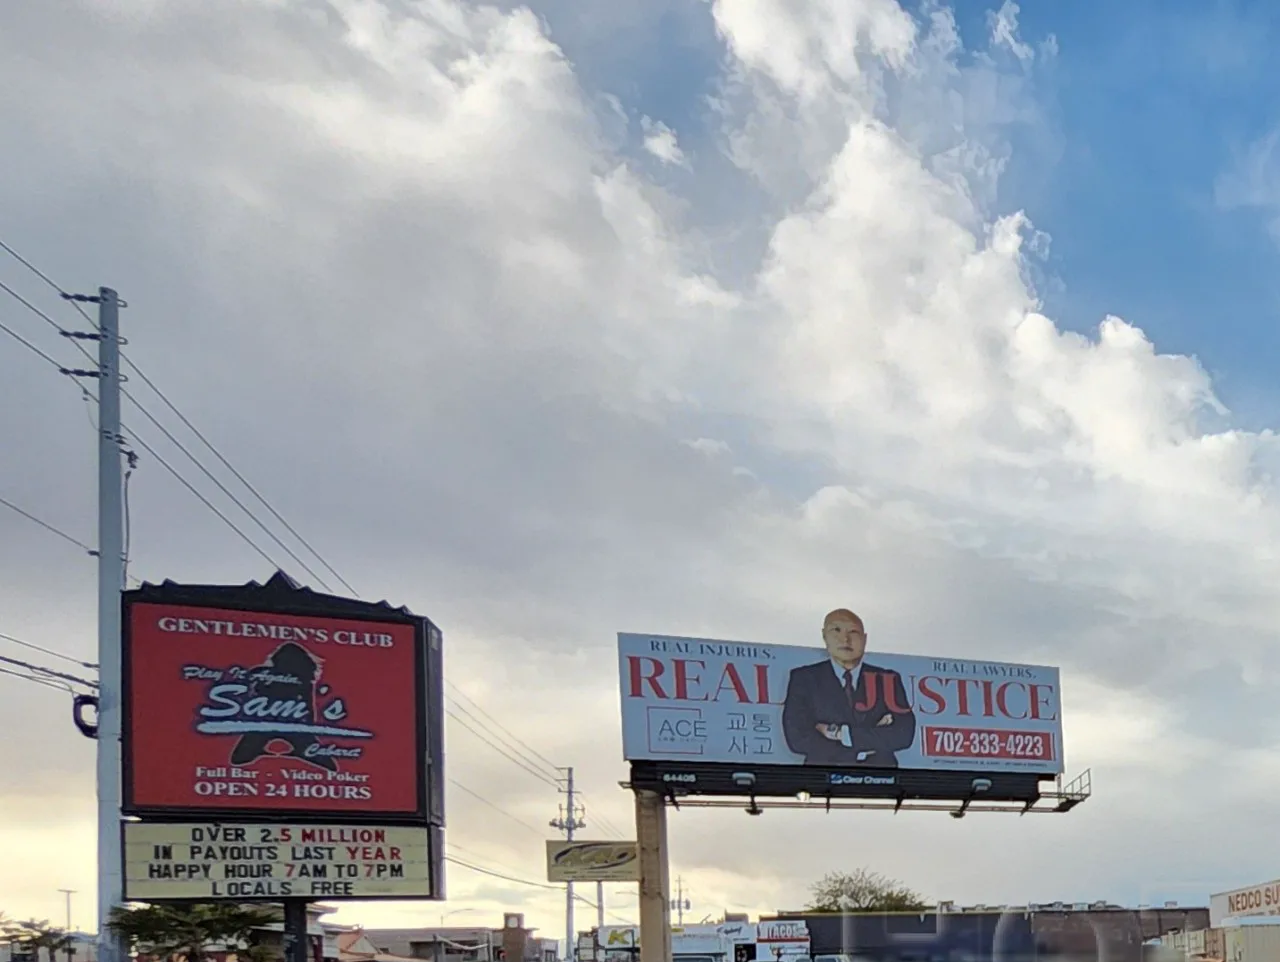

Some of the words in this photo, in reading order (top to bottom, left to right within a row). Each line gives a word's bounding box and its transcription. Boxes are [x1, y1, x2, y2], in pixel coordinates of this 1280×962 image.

[157, 616, 329, 643] GENTLEMEN'S
[333, 629, 394, 648] CLUB
[650, 640, 692, 654] REAL
[700, 643, 777, 660] INJURIES.
[183, 666, 223, 681] Play
[229, 666, 247, 679] It
[932, 661, 969, 675] REAL
[626, 655, 785, 705] REAL
[855, 671, 1058, 721] JUSTICE
[200, 684, 346, 720] Sam's
[658, 719, 708, 737] ACE
[304, 742, 361, 757] Cabaret
[727, 735, 774, 755] 사고
[932, 730, 1044, 757] 702-333-4223
[195, 766, 227, 778] Full
[231, 767, 260, 779] Bar
[280, 768, 324, 781] Video
[327, 770, 371, 783] Poker
[194, 781, 259, 796] OPEN
[265, 783, 289, 797] 24
[293, 783, 372, 799] HOURS
[191, 827, 247, 843] OVER
[260, 828, 292, 843] 2.5
[301, 828, 386, 843] MILLION
[153, 845, 173, 860] IN
[189, 845, 278, 860] PAYOUTS
[291, 846, 336, 860] LAST
[347, 847, 402, 860] YEAR
[149, 863, 212, 879] HAPPY
[224, 863, 273, 879] HOUR
[334, 863, 358, 878] TO
[364, 863, 404, 878] 7PM
[211, 881, 292, 896] LOCALS
[311, 882, 354, 896] FREE
[1228, 888, 1262, 914] NEDCO
